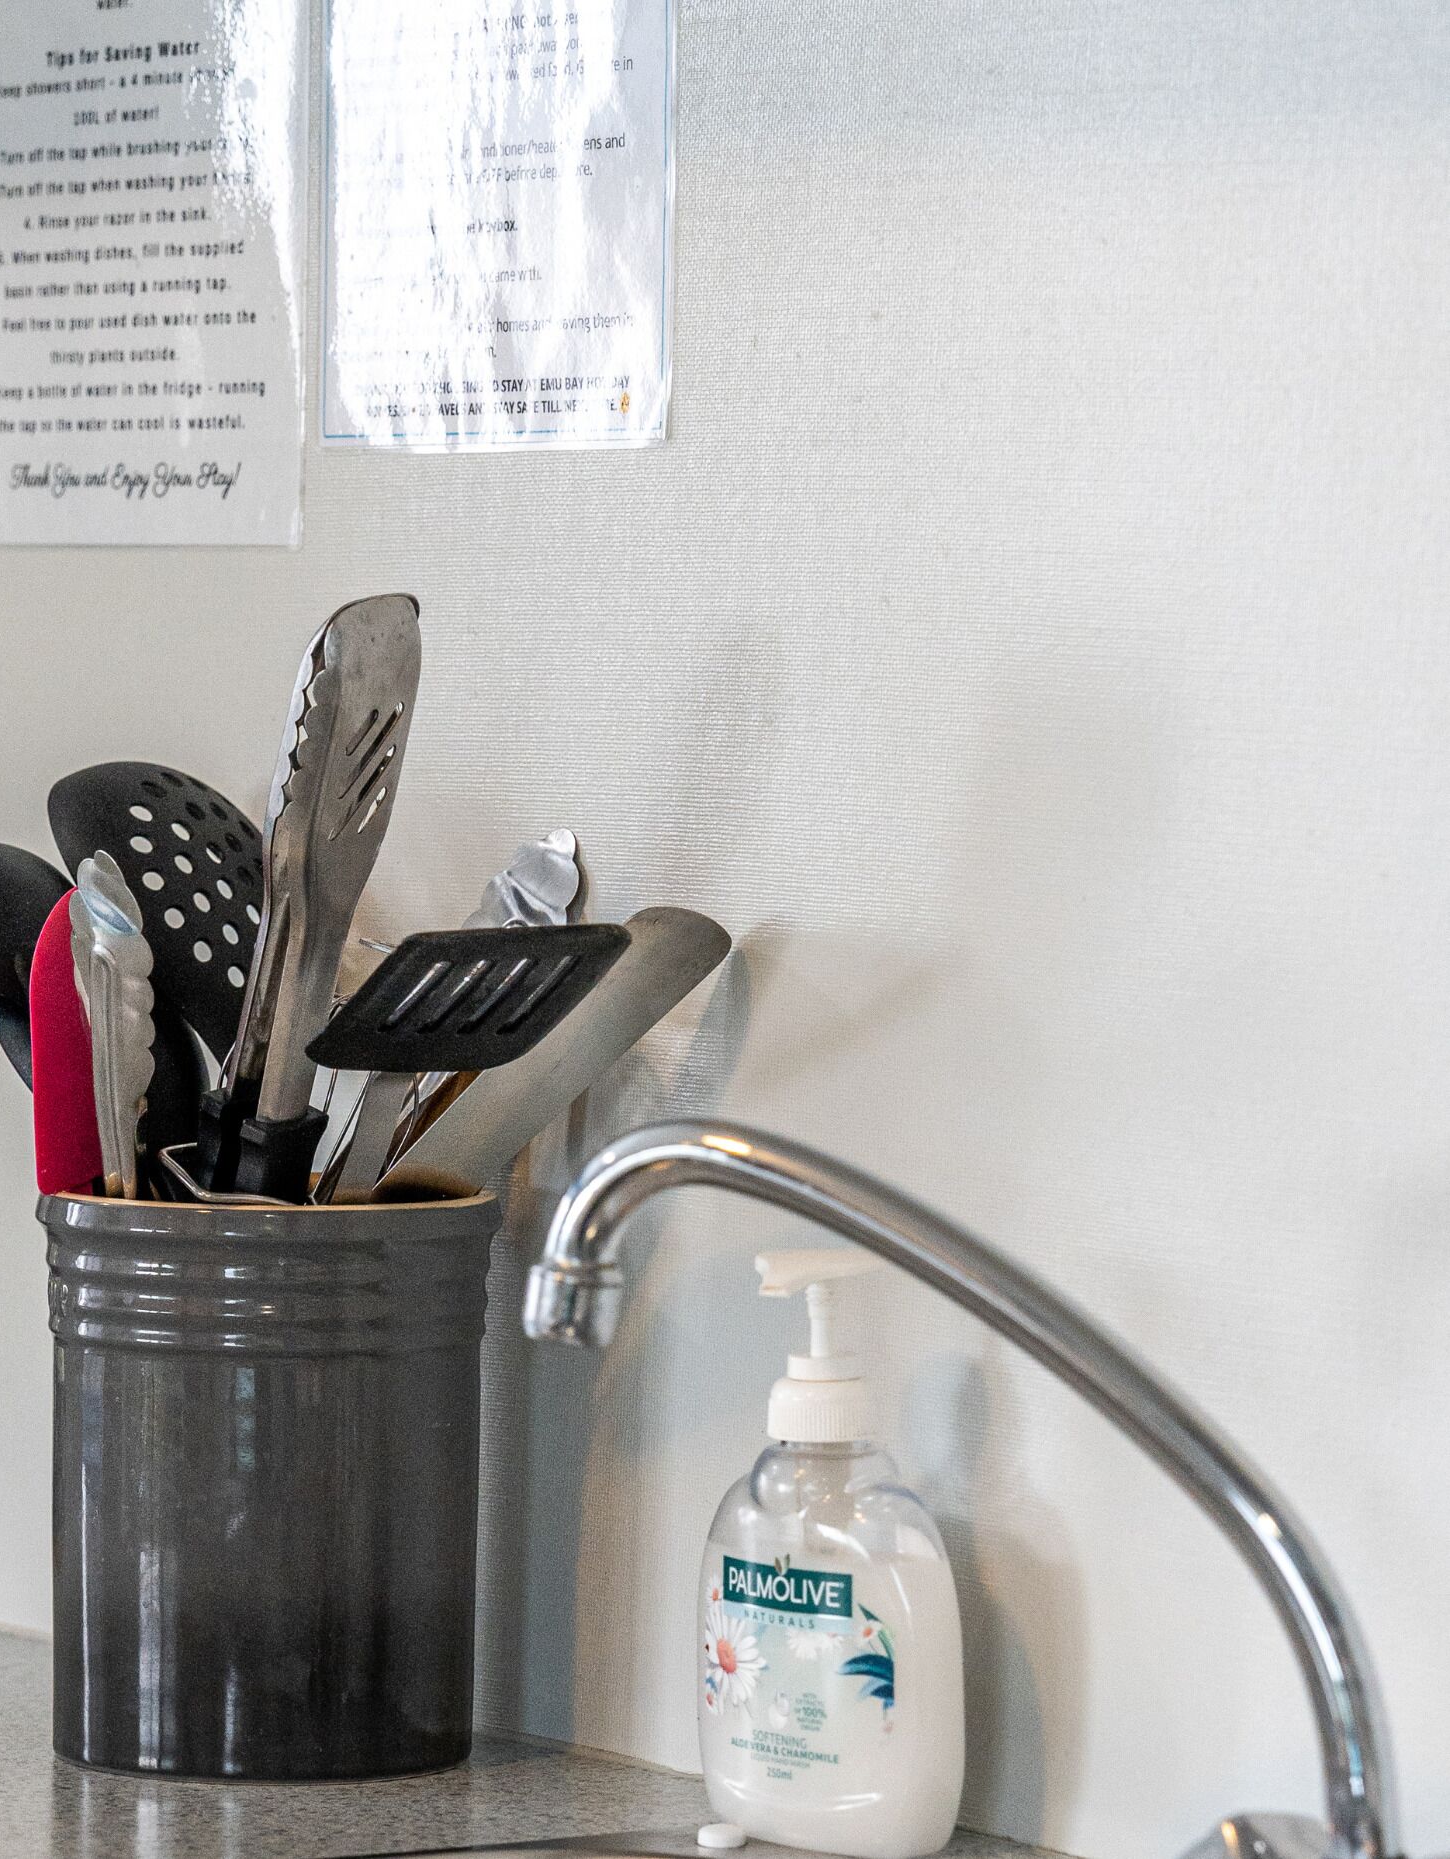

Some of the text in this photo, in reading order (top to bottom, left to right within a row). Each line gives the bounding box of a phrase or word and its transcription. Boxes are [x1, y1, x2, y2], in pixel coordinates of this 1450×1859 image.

[46, 40, 201, 71] Tips for Saving Water
[623, 56, 633, 70] in
[26, 80, 71, 96] showers
[76, 77, 105, 94] short
[119, 76, 127, 88] a
[131, 74, 139, 87] 4
[144, 71, 183, 86] minute
[73, 105, 160, 126] 100L of water!
[605, 132, 626, 149] and
[0, 150, 25, 167] Turn
[29, 147, 44, 163] off
[47, 147, 65, 161] the
[69, 147, 87, 164] tap
[91, 142, 121, 159] while
[126, 140, 180, 158] brushing
[0, 182, 24, 199] Turn
[28, 180, 43, 196] off
[46, 180, 64, 195] the
[68, 179, 86, 198] tap
[91, 176, 120, 192] when
[126, 172, 175, 192] washing
[179, 172, 208, 190] your
[38, 213, 70, 229] Rinse
[74, 211, 100, 230] your
[104, 210, 135, 226] razor
[139, 209, 151, 224] in
[156, 207, 176, 223] the
[181, 204, 213, 222] sink.
[12, 249, 40, 265] When
[45, 246, 90, 265] washing
[95, 241, 137, 261] dishes,
[142, 240, 160, 258] fill
[164, 239, 183, 256] the
[190, 239, 245, 258] supplied
[4, 276, 232, 300] basin rather than using a running tap.
[2, 318, 27, 332] Feel
[69, 314, 95, 333] pour
[99, 313, 128, 329] used
[132, 311, 158, 327] dish
[163, 310, 198, 326] water
[204, 310, 232, 325] onto
[237, 310, 257, 325] the
[497, 317, 530, 333] homes
[50, 344, 180, 366] thirsty plants outside.
[28, 386, 34, 399] a
[37, 382, 68, 398] bottle
[71, 382, 82, 398] of
[86, 381, 118, 397] water
[122, 379, 134, 395] in
[138, 379, 158, 395] the
[163, 378, 202, 397] fridge
[218, 378, 266, 397] running
[501, 379, 524, 393] STAY
[540, 378, 562, 391] EMU
[565, 376, 584, 390] BAY
[541, 399, 562, 413] TILL
[55, 417, 73, 432] the
[77, 416, 107, 432] water
[112, 416, 134, 431] can
[138, 415, 165, 430] cool
[170, 415, 180, 430] is
[188, 413, 246, 430] wasteful.
[8, 462, 242, 500] Thank You and Enjoy Your Stay!
[728, 1565, 841, 1609] PALMOLIVE
[744, 1608, 816, 1630] NATURALS
[731, 1736, 749, 1750] ALOE
[750, 1741, 772, 1754] VERA
[780, 1747, 839, 1765] CHAMOMILE
[752, 1729, 807, 1750] SOFTENING
